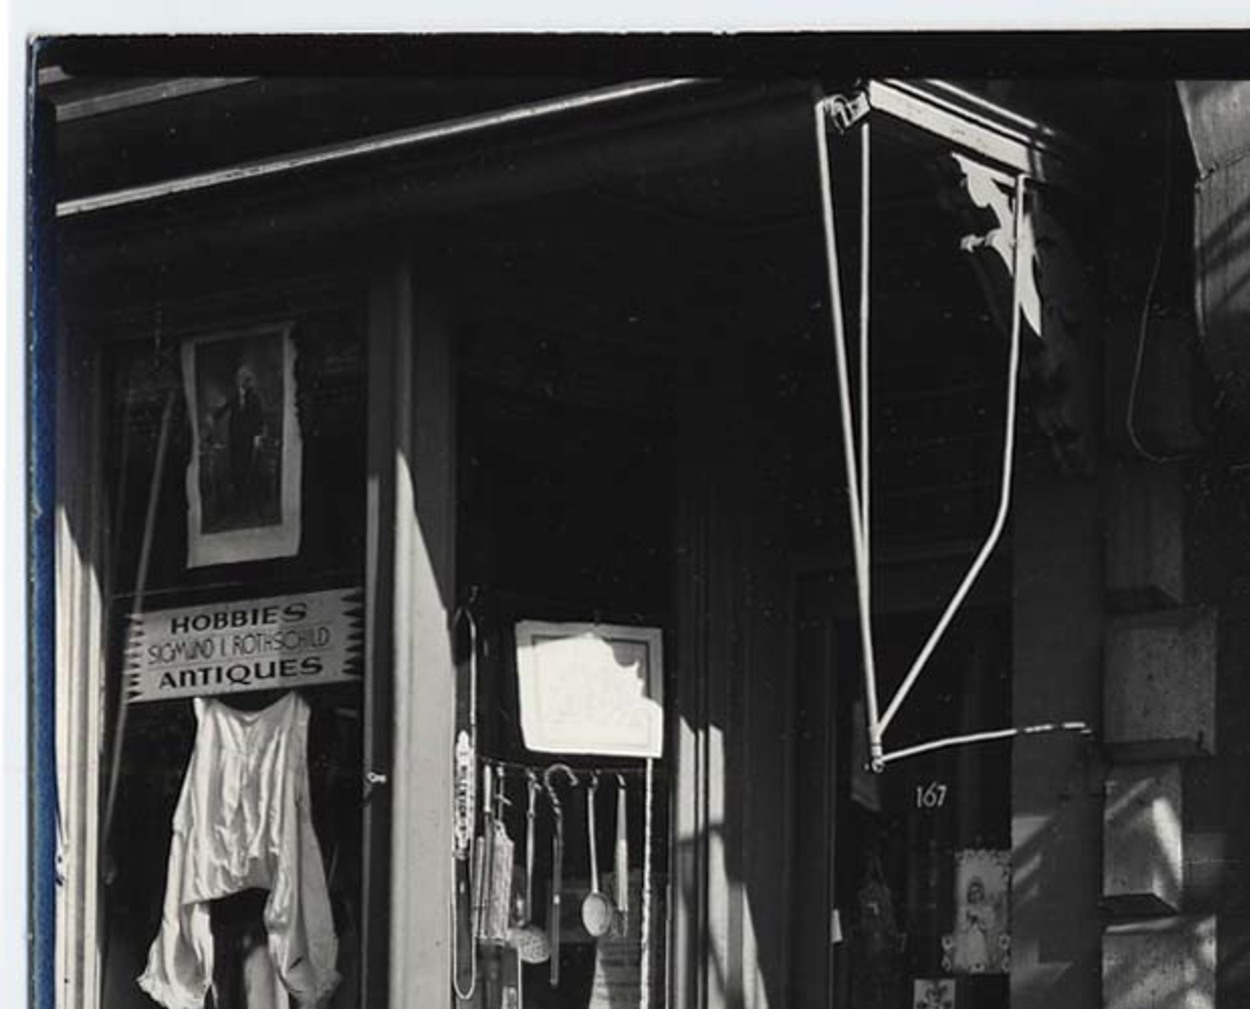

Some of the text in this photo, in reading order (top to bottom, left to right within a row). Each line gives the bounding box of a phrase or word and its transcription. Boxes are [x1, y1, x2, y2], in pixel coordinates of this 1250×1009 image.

[171, 603, 308, 635] HOBBIES
[159, 656, 323, 690] ANTIQUES
[916, 781, 948, 808] 167
